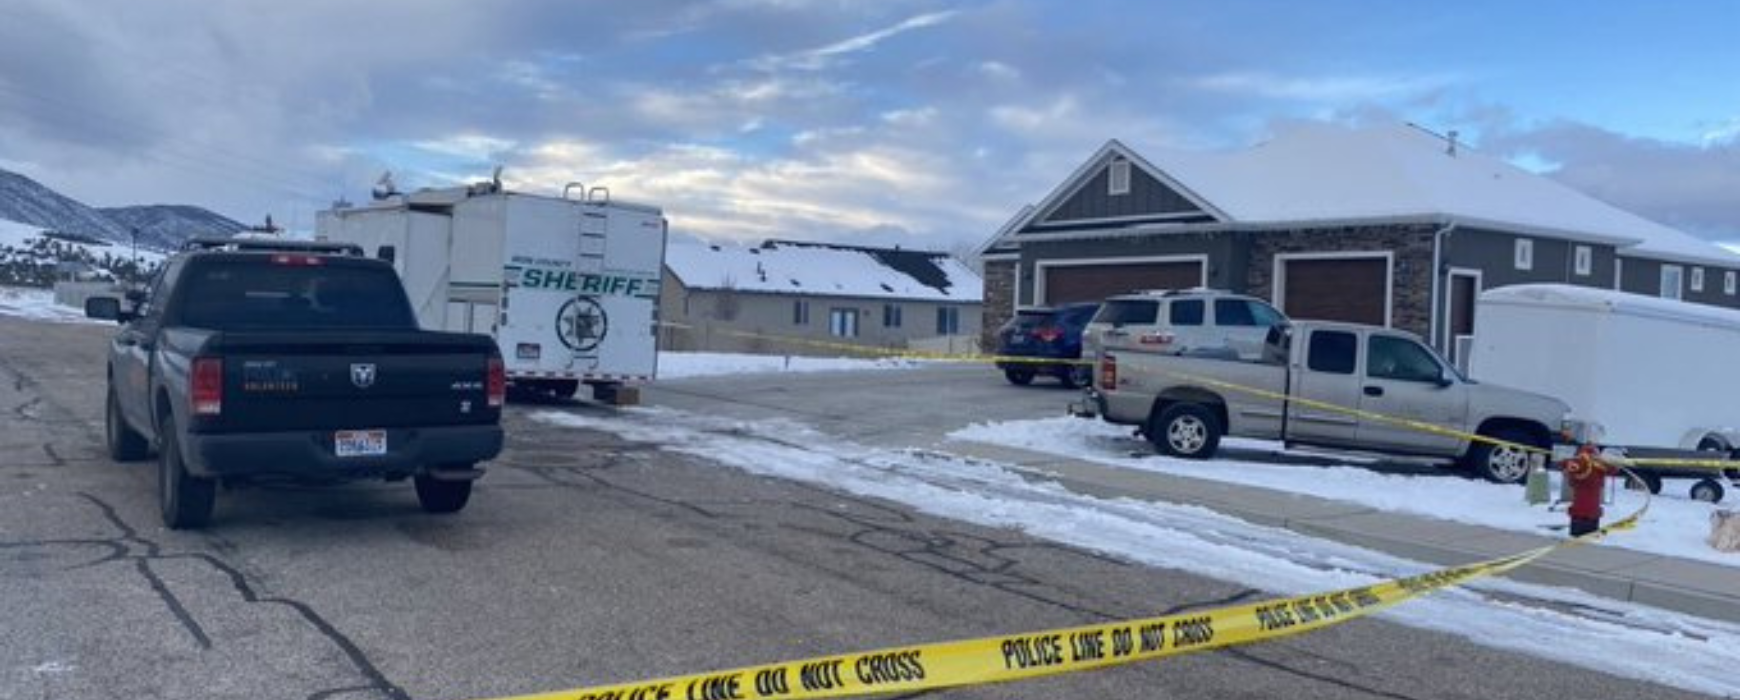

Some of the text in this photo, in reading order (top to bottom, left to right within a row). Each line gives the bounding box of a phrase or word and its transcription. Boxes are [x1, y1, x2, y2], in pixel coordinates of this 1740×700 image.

[522, 268, 644, 295] SHERIFF
[1001, 616, 1214, 669] POLICE LINE DO NOT CROSS
[687, 672, 745, 700] LINE
[755, 668, 789, 696] DO
[800, 660, 845, 691] NOT
[855, 650, 925, 685] CROSS
